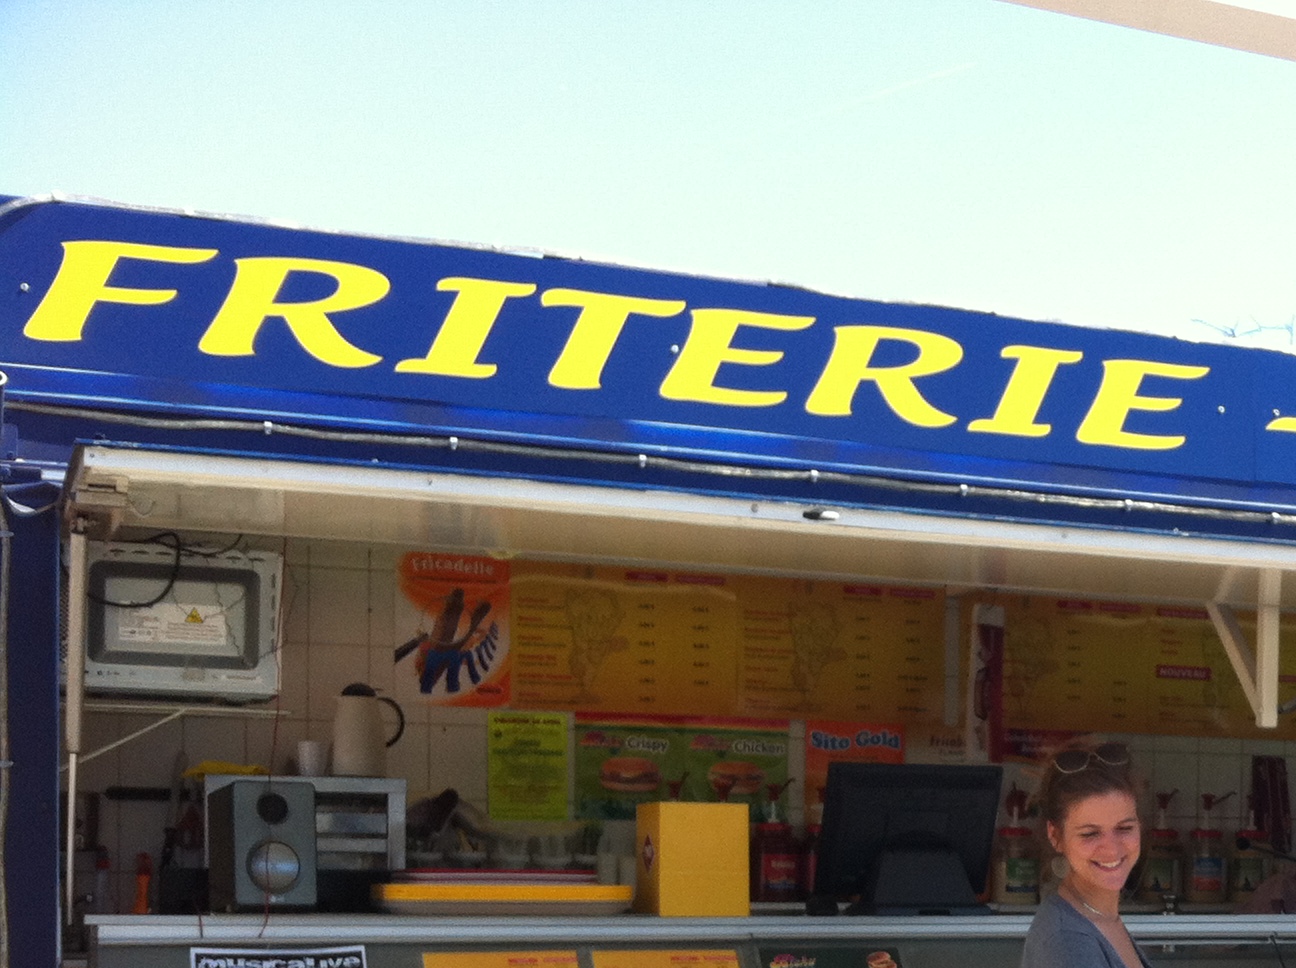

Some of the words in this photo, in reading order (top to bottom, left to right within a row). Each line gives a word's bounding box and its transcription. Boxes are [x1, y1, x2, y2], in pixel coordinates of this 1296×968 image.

[26, 242, 1207, 448] FRITERIE
[1159, 667, 1207, 678] NOUVEAU
[626, 736, 668, 753] Crispy
[733, 740, 785, 754] Chicken
[811, 731, 850, 750] Sito
[855, 730, 900, 748] Gold
